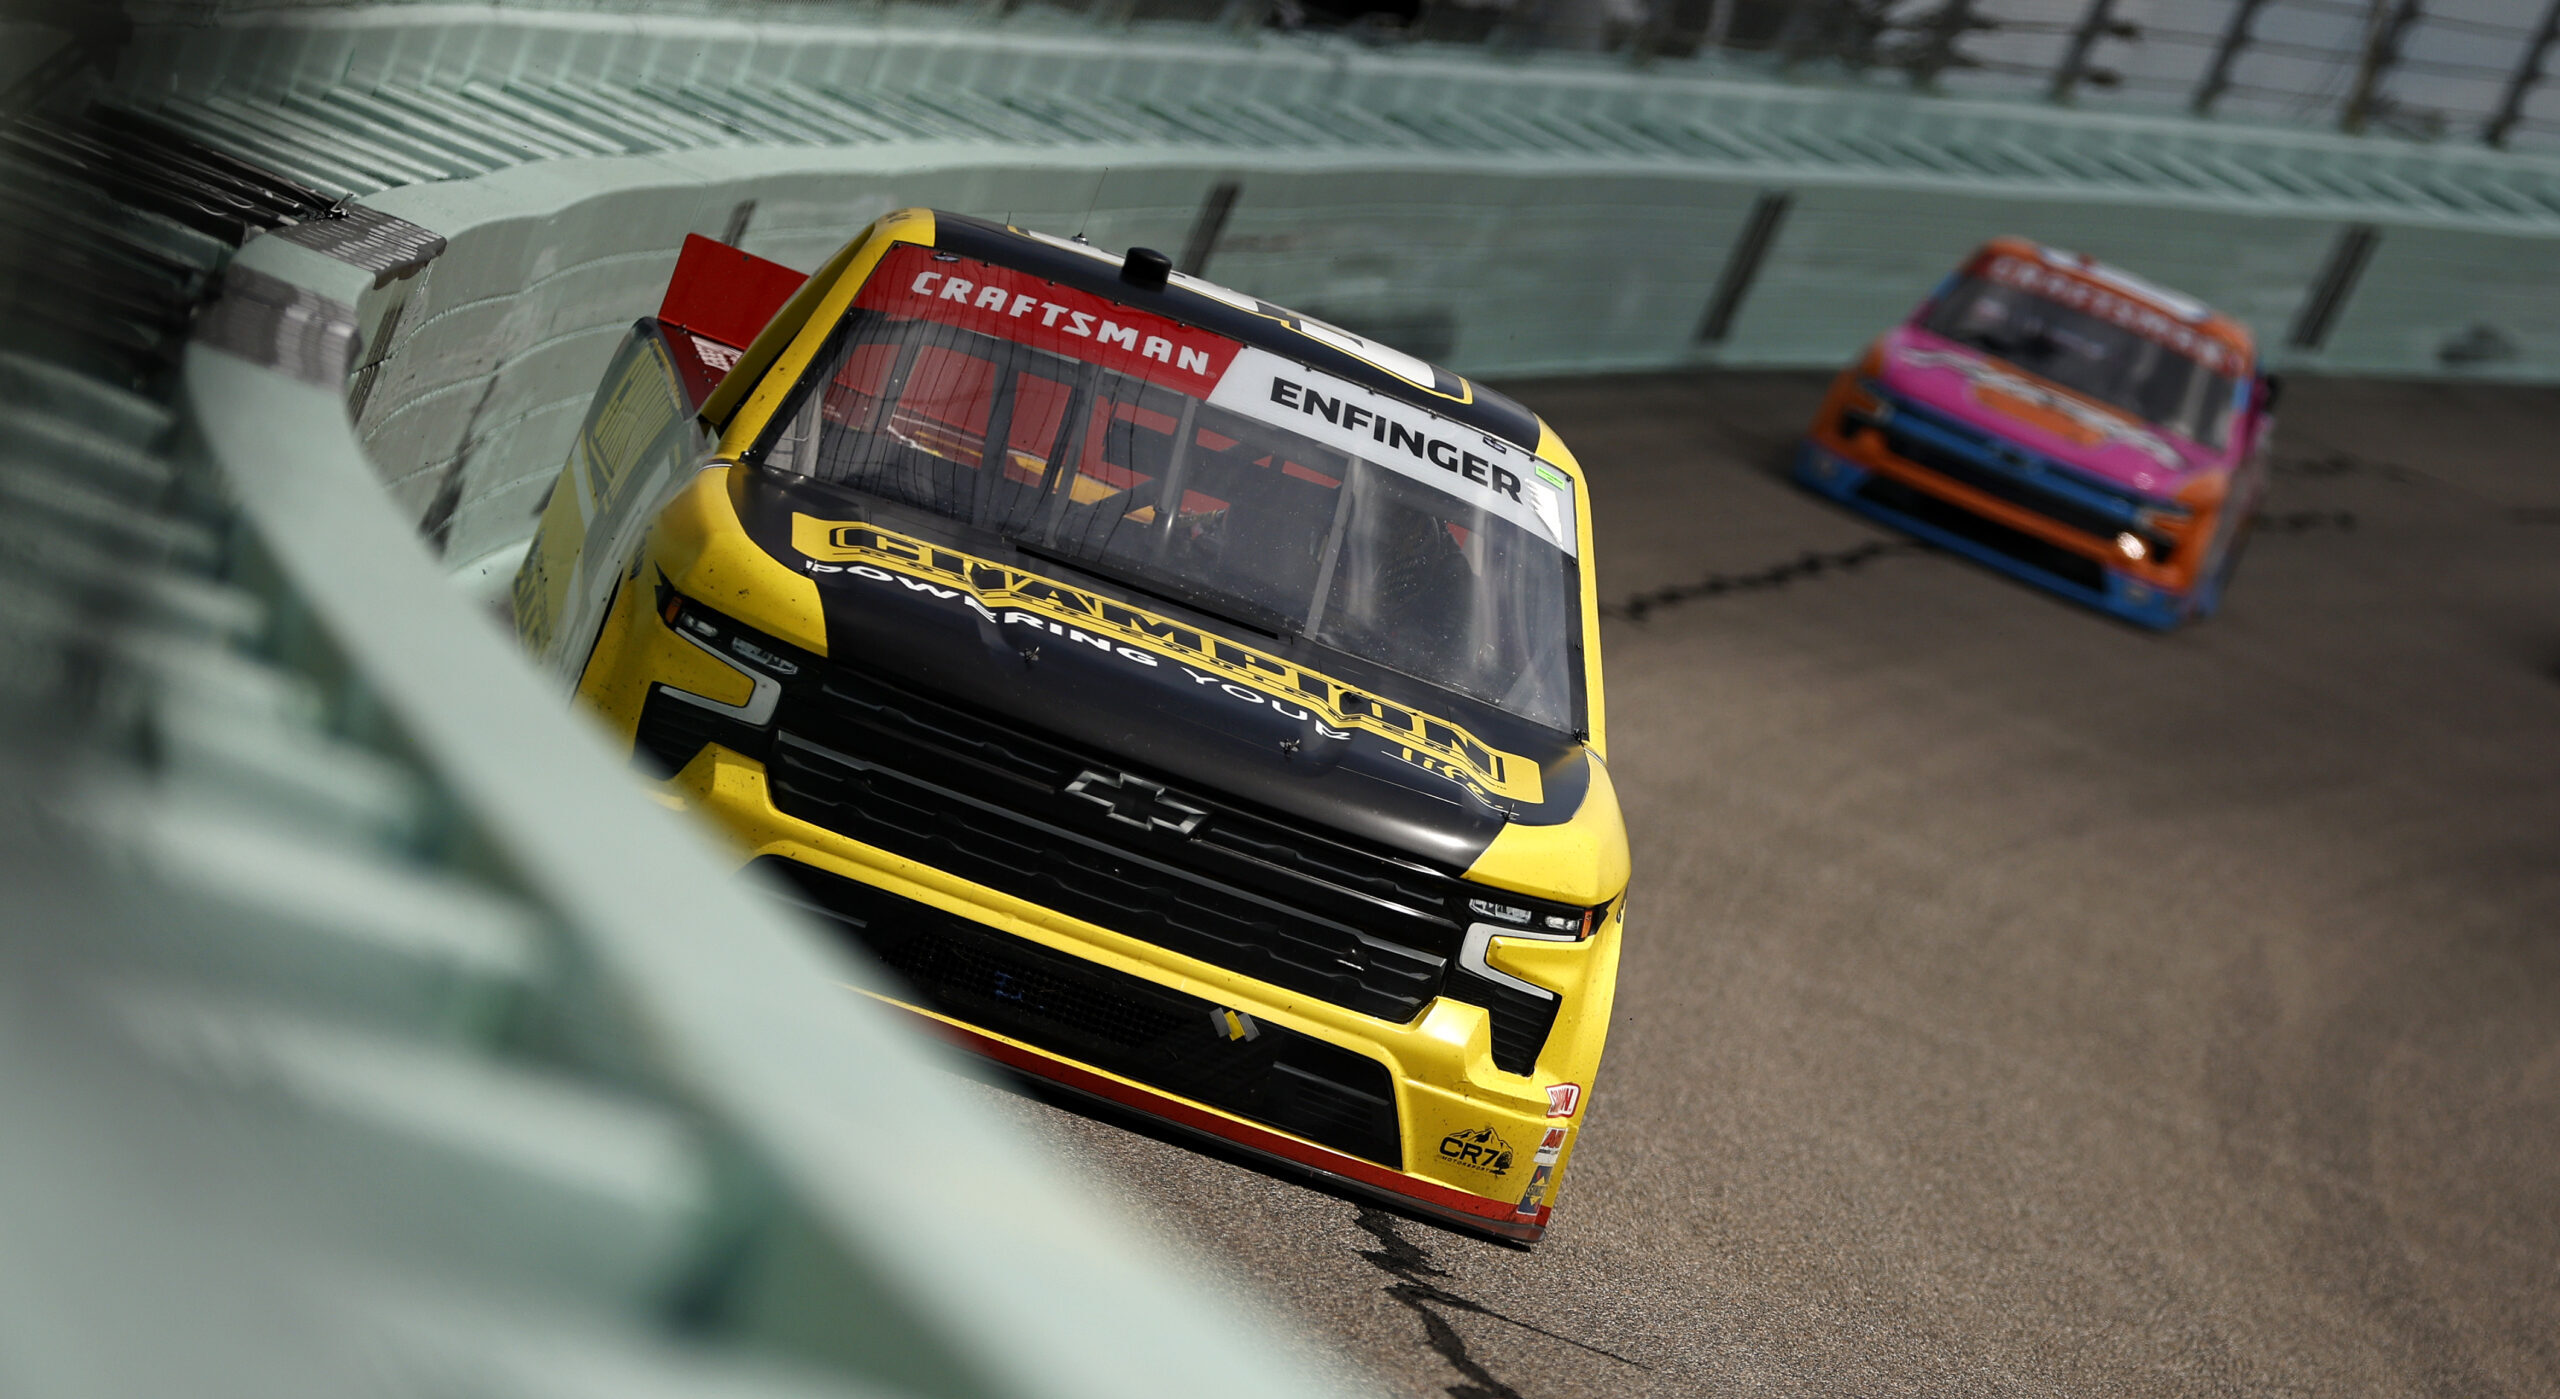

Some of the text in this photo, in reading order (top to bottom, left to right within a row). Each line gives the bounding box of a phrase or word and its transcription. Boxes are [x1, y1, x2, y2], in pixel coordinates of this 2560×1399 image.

[911, 270, 1210, 376] CRAFTSMAN
[1270, 376, 1525, 505] ENFINGER
[805, 559, 1158, 667] POWERING
[1180, 666, 1351, 741] YOUR
[1439, 1136, 1500, 1166] CR7
